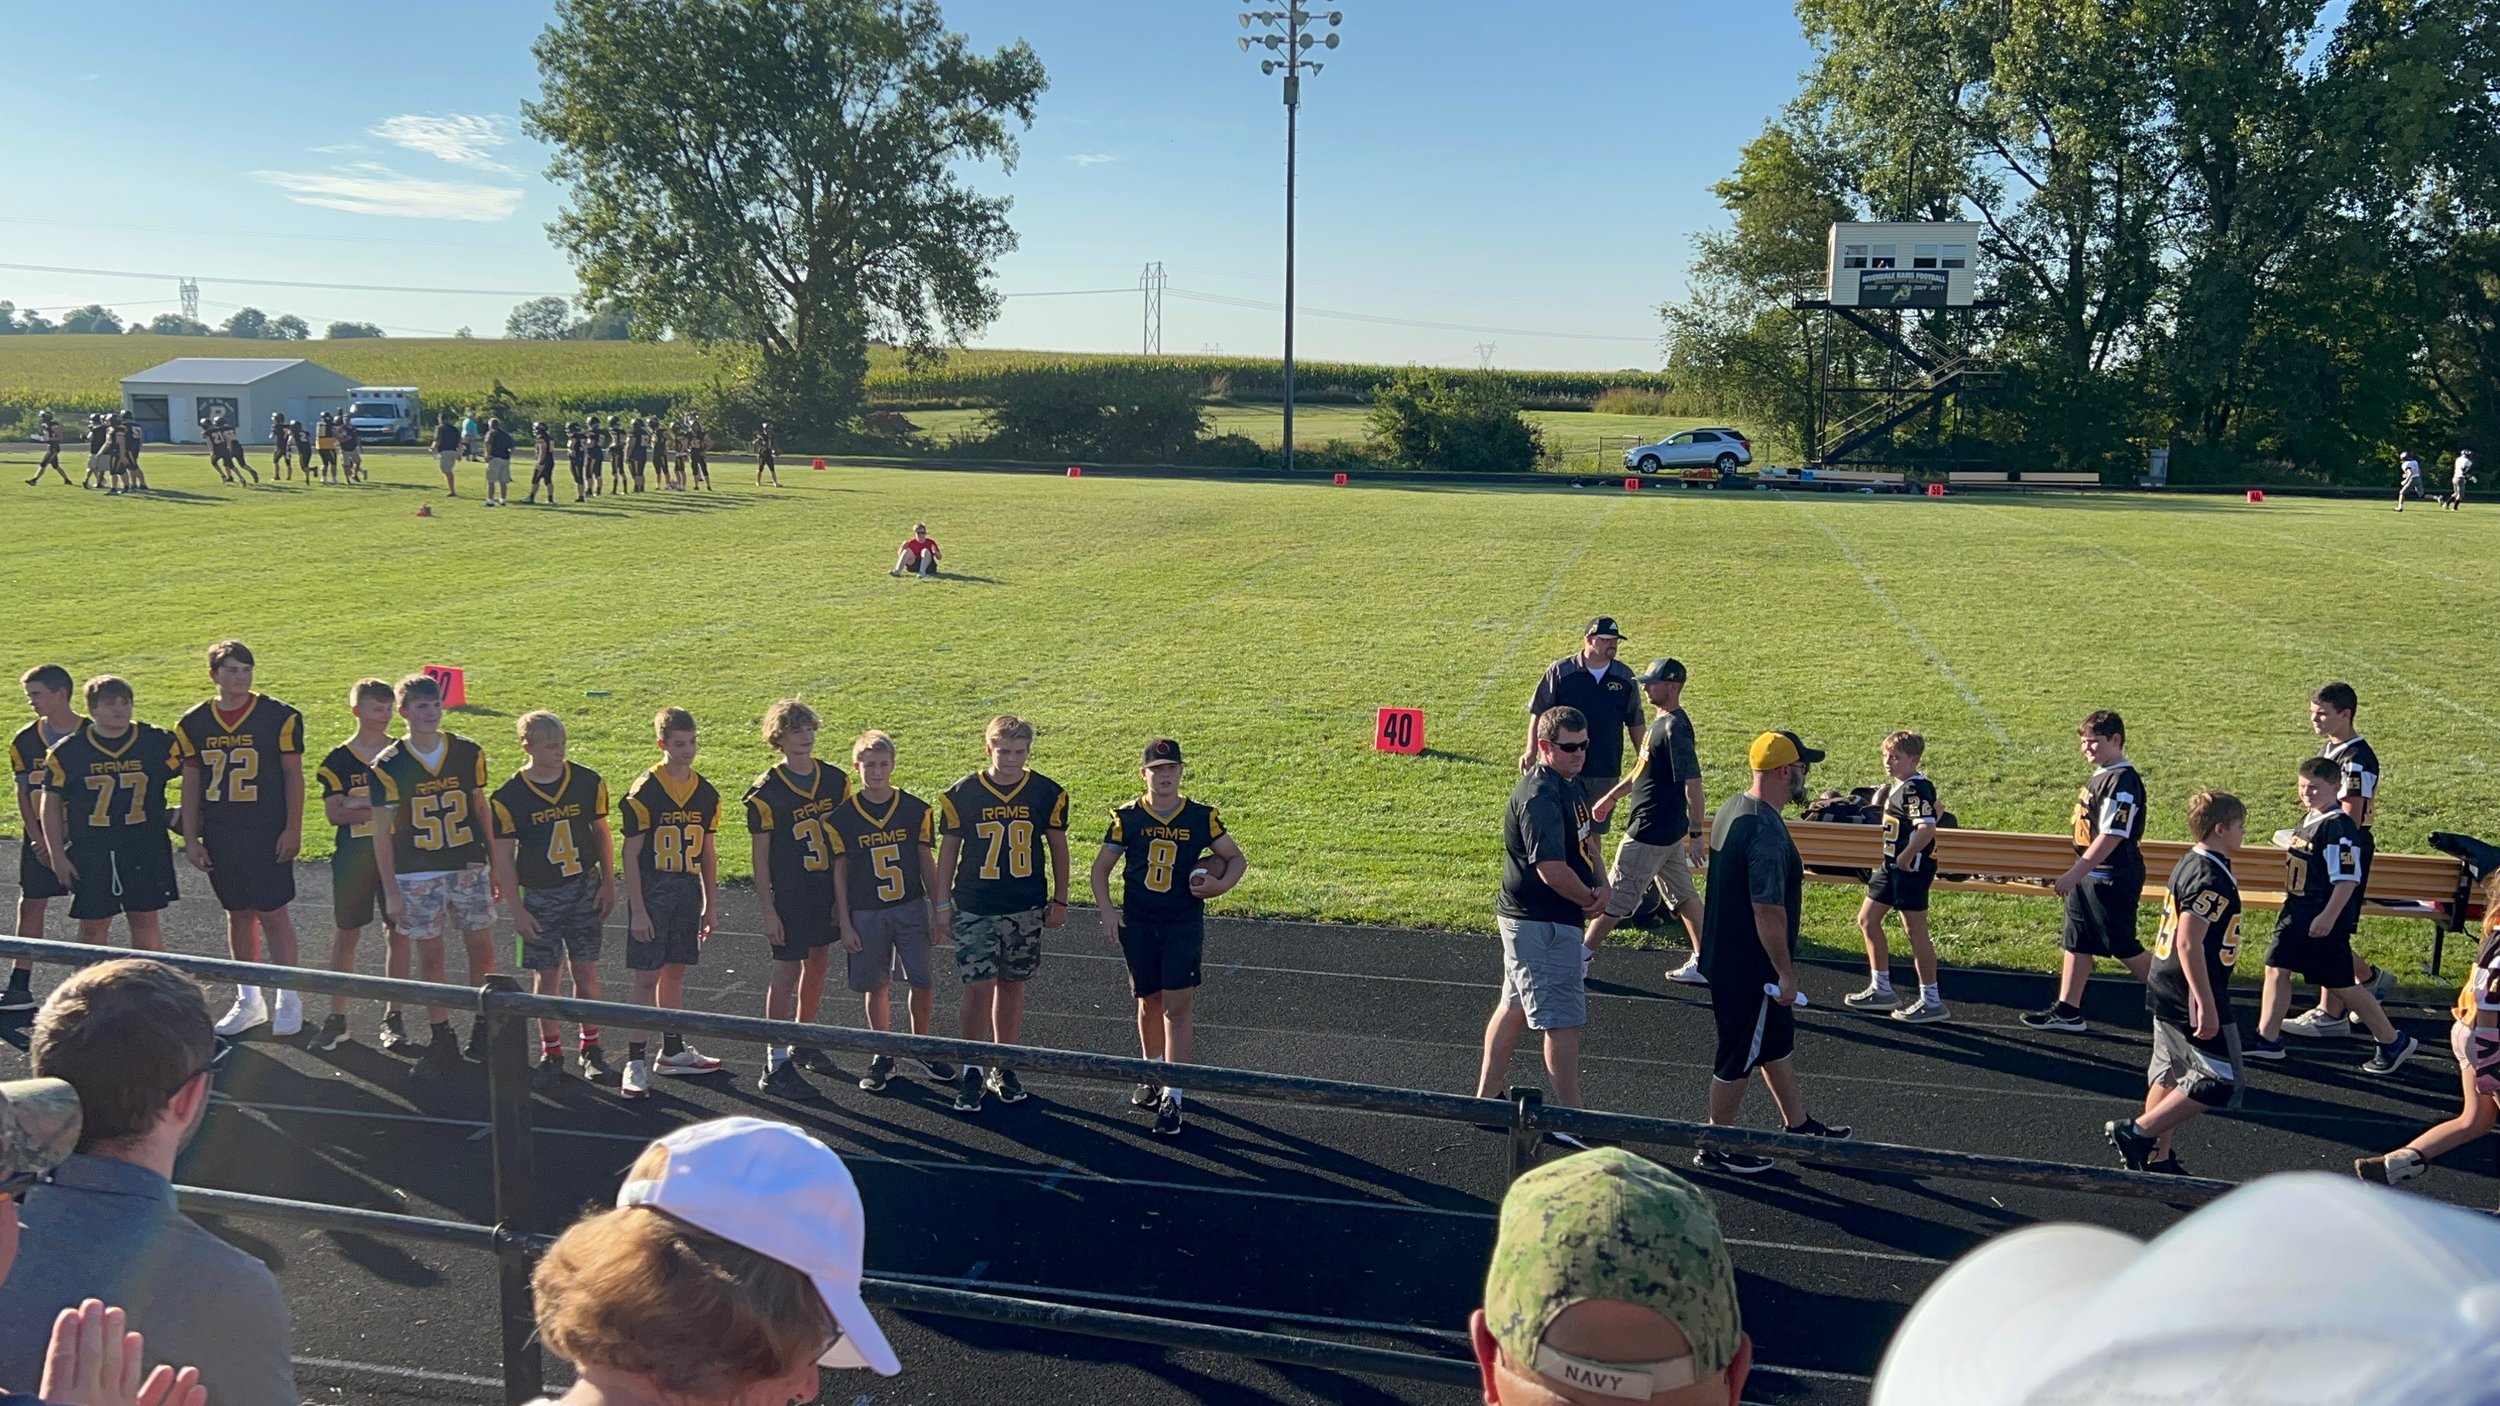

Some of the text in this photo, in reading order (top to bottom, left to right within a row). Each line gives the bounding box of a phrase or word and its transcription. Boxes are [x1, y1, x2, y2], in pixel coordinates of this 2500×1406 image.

[1916, 272, 1946, 283] FOOTBALL
[1932, 485, 1941, 496] 50
[2251, 492, 2261, 502] 40
[206, 734, 254, 748] RAMS
[1384, 713, 1413, 748] 40
[90, 759, 143, 775] RAMS
[201, 747, 259, 802] 72
[415, 776, 460, 796] RAMS
[85, 772, 149, 827] 77
[793, 798, 833, 821] RAMS
[1907, 796, 1933, 817] 22
[411, 789, 474, 851] 52
[531, 804, 580, 825] RAMS
[982, 805, 1030, 821] RAMS
[793, 818, 830, 872] 3
[858, 829, 908, 848] RAMS
[1141, 826, 1191, 841] RAMS
[547, 818, 584, 877] 4
[654, 824, 704, 875] 82
[976, 820, 1035, 880] 78
[2341, 852, 2354, 865] 50
[870, 844, 906, 902] 5
[1144, 838, 1179, 893] 8
[2192, 889, 2230, 923] 53
[1565, 1364, 1623, 1391] NAVY
